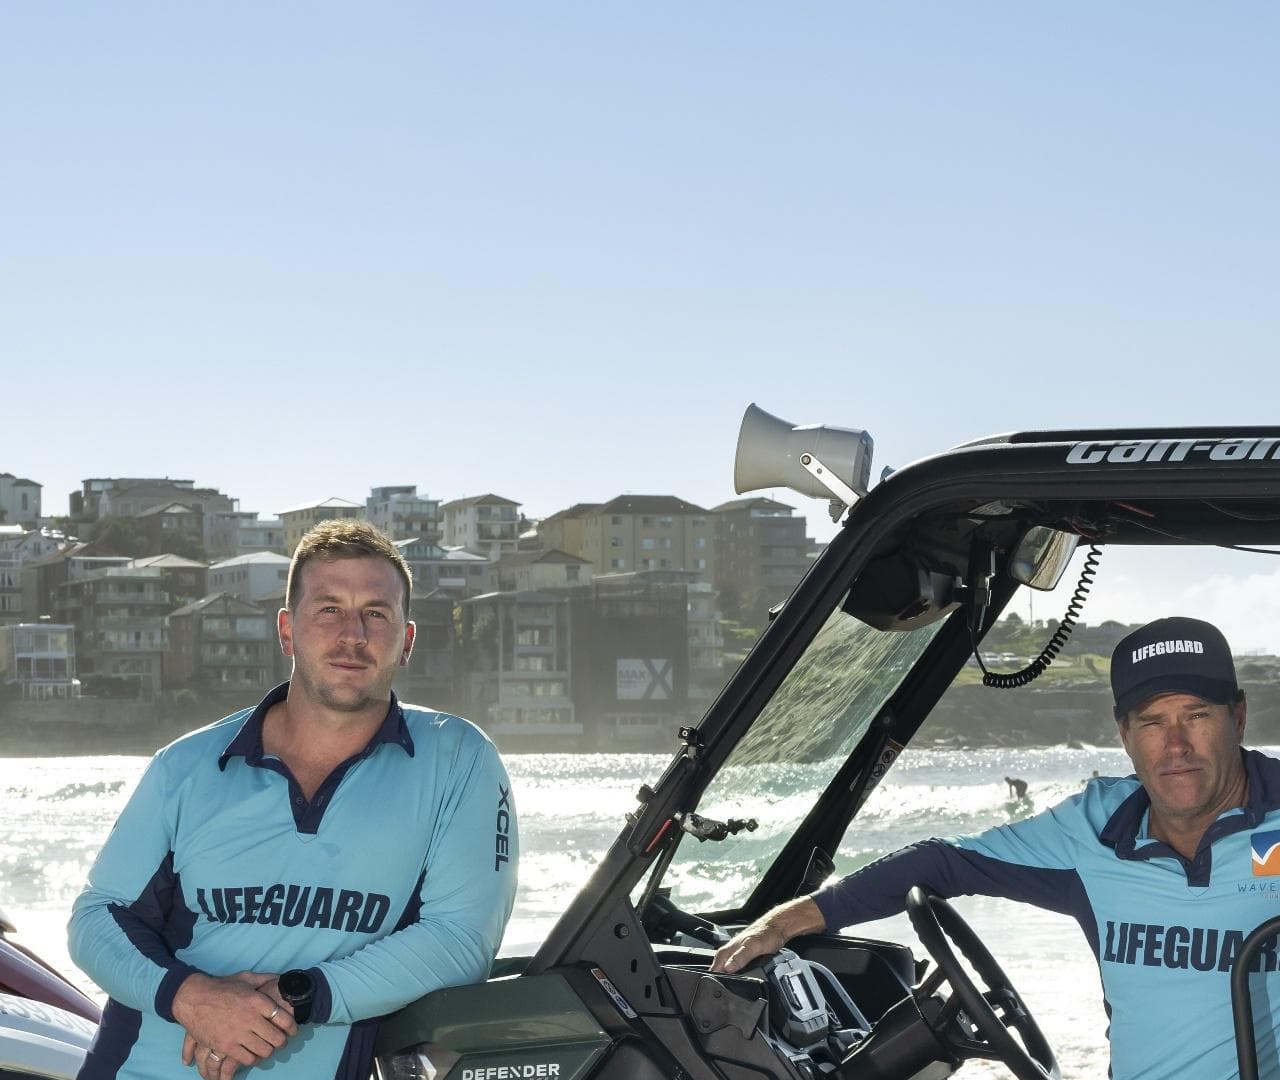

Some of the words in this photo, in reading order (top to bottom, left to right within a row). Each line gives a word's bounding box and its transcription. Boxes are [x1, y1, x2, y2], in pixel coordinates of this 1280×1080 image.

[1132, 640, 1204, 664] LIFEGUARD
[494, 782, 510, 872] XCEL
[196, 883, 391, 934] LIFEGUARD
